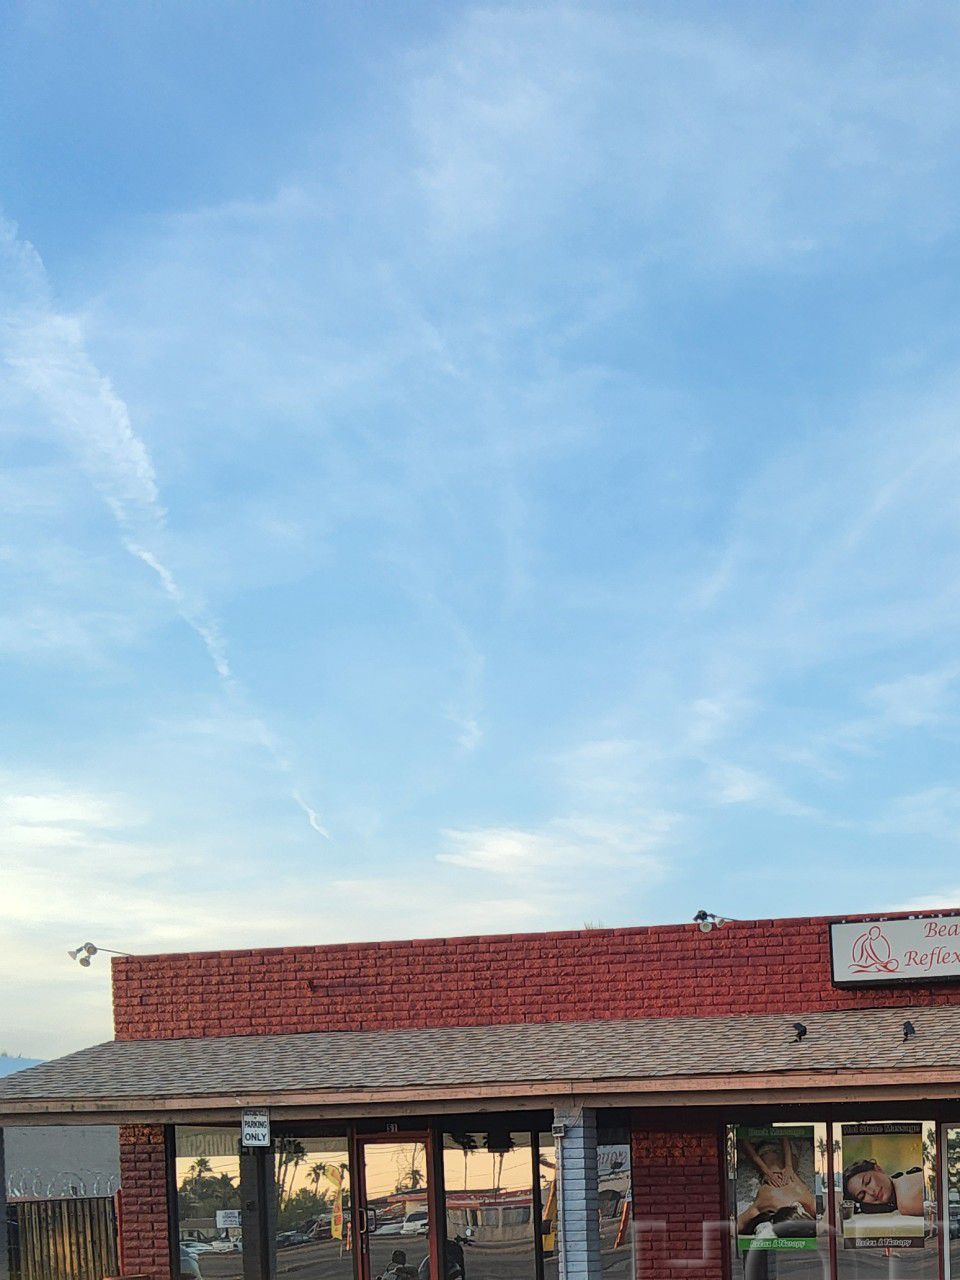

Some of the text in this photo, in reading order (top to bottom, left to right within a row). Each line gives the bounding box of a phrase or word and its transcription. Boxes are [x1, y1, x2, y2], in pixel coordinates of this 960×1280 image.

[244, 1120, 268, 1129] PARKING
[884, 1123, 921, 1133] Massage
[244, 1132, 267, 1142] ONLY
